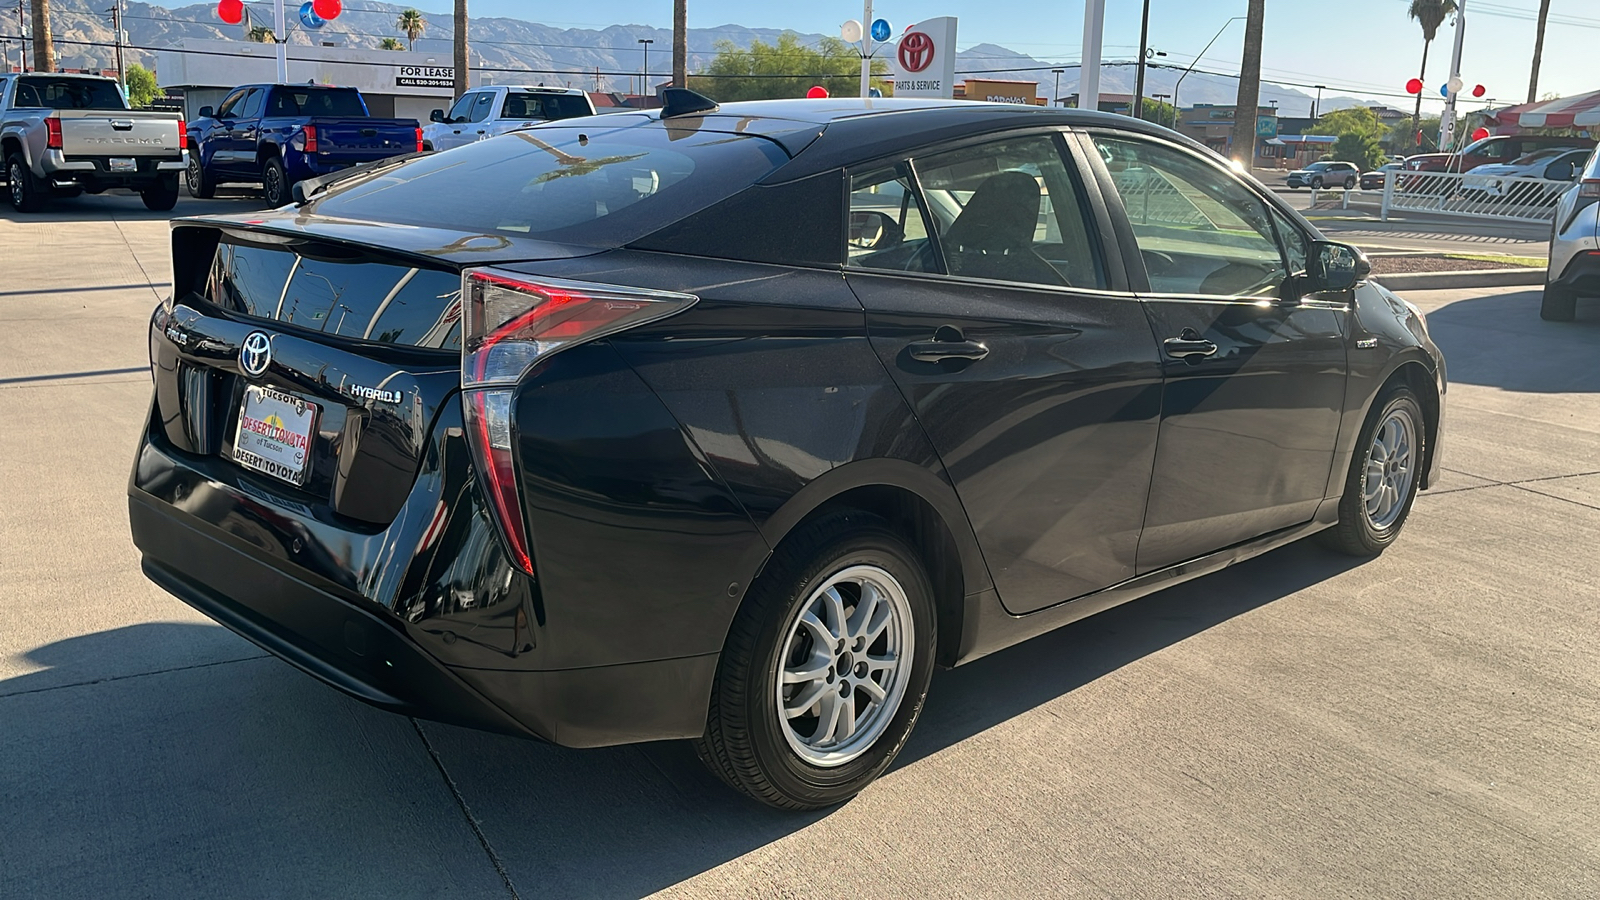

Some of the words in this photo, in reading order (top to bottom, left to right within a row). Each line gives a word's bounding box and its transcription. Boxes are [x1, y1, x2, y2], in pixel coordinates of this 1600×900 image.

[400, 67, 421, 76] FOR
[424, 68, 453, 78] LEASE
[895, 80, 910, 90] PARTS
[910, 80, 916, 90] &
[916, 80, 940, 90] SERVICE
[83, 137, 163, 145] TACOMA
[337, 142, 402, 150] TACOMA
[262, 389, 296, 405] TUCSON
[351, 384, 393, 402] HYBRID
[242, 417, 272, 437] DESERT
[274, 426, 306, 449] TOYOTA
[256, 438, 264, 446] of
[263, 439, 283, 454] Tucson
[235, 449, 263, 468] DESERT
[265, 461, 298, 483] TOYOTA
